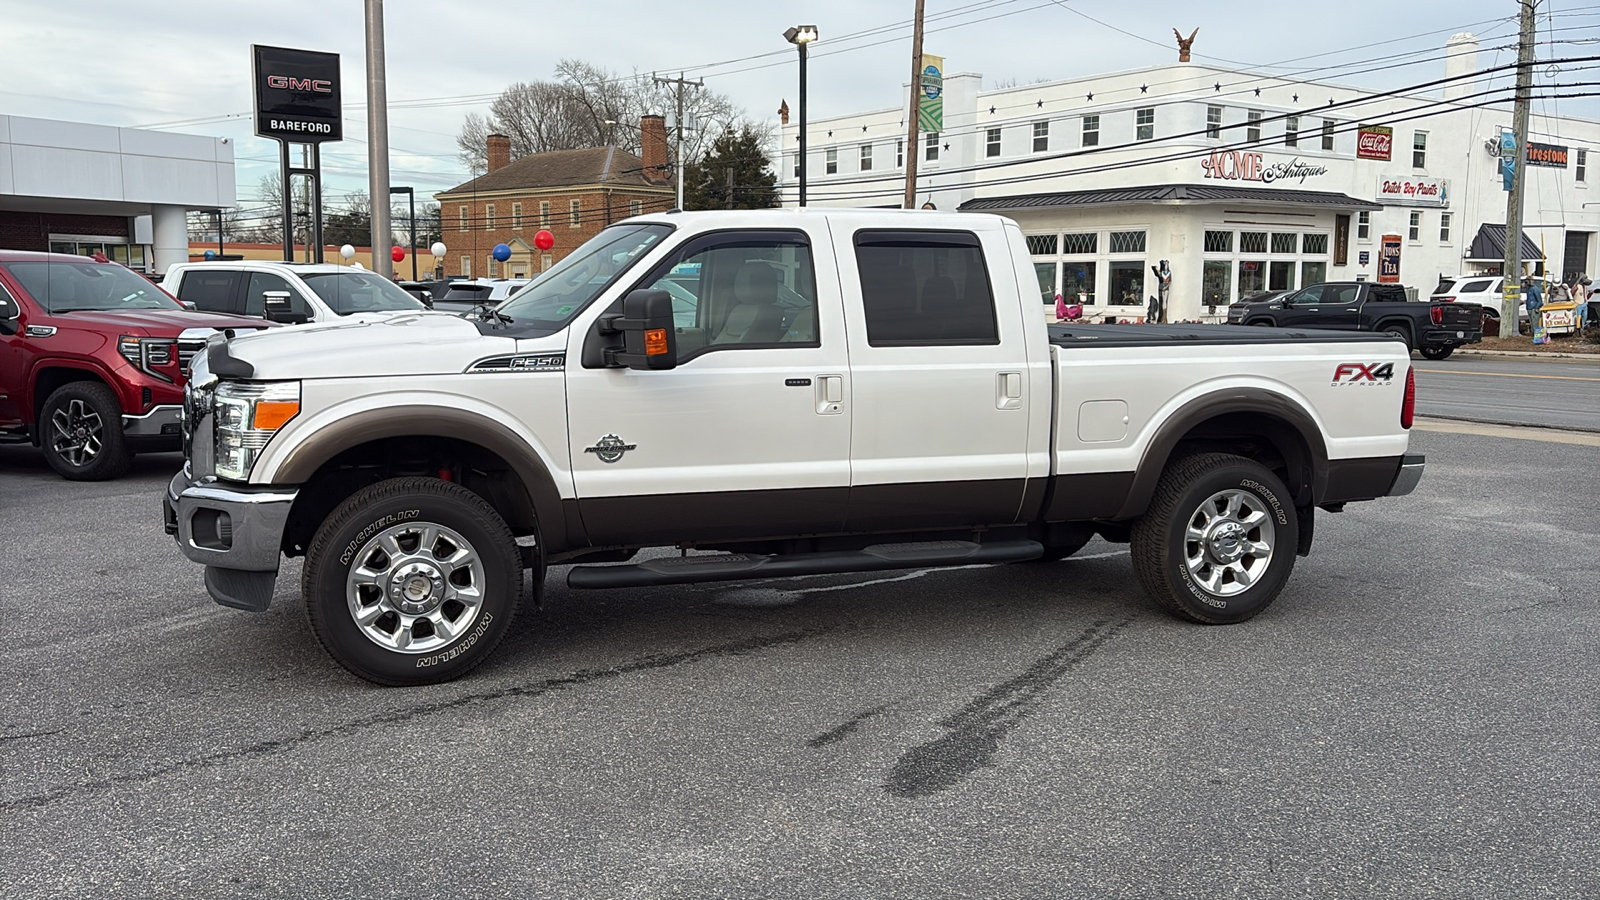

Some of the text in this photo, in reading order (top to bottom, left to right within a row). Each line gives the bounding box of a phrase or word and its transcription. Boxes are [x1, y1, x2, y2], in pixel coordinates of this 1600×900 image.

[267, 75, 332, 93] GMC
[270, 119, 331, 133] BAREFORD
[1201, 148, 1263, 181] ACME
[1278, 156, 1328, 184] Antiques
[1382, 180, 1438, 197] Dutch Boy Paints
[1332, 362, 1394, 382] FX4
[1240, 479, 1287, 525] MICHELIN
[340, 509, 420, 566] MICHELIN
[1179, 564, 1227, 608] MICHELIN
[416, 612, 494, 667] MICHELIN
